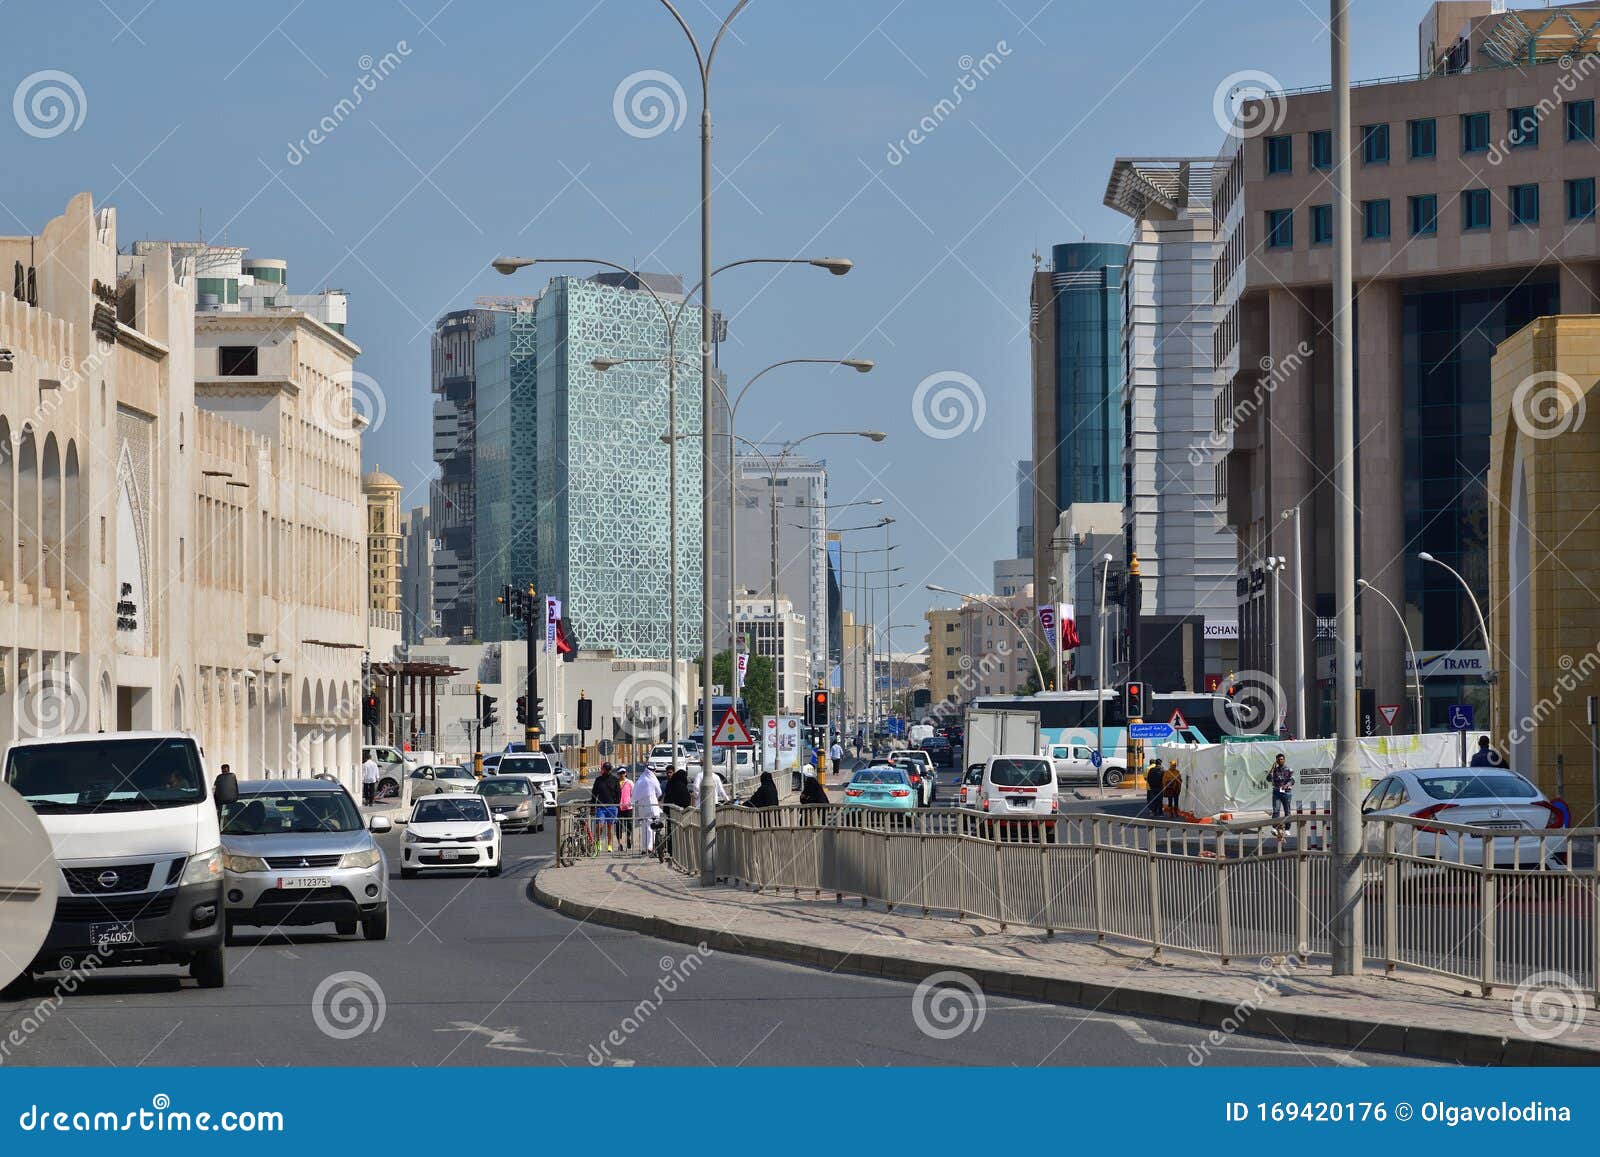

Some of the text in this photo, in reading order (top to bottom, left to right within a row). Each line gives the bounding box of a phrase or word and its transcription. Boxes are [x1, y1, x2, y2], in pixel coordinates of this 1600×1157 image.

[1203, 625, 1238, 635] XCHAN
[1442, 658, 1482, 669] TRAVEL
[298, 878, 327, 887] 112375
[98, 931, 133, 943] 254067
